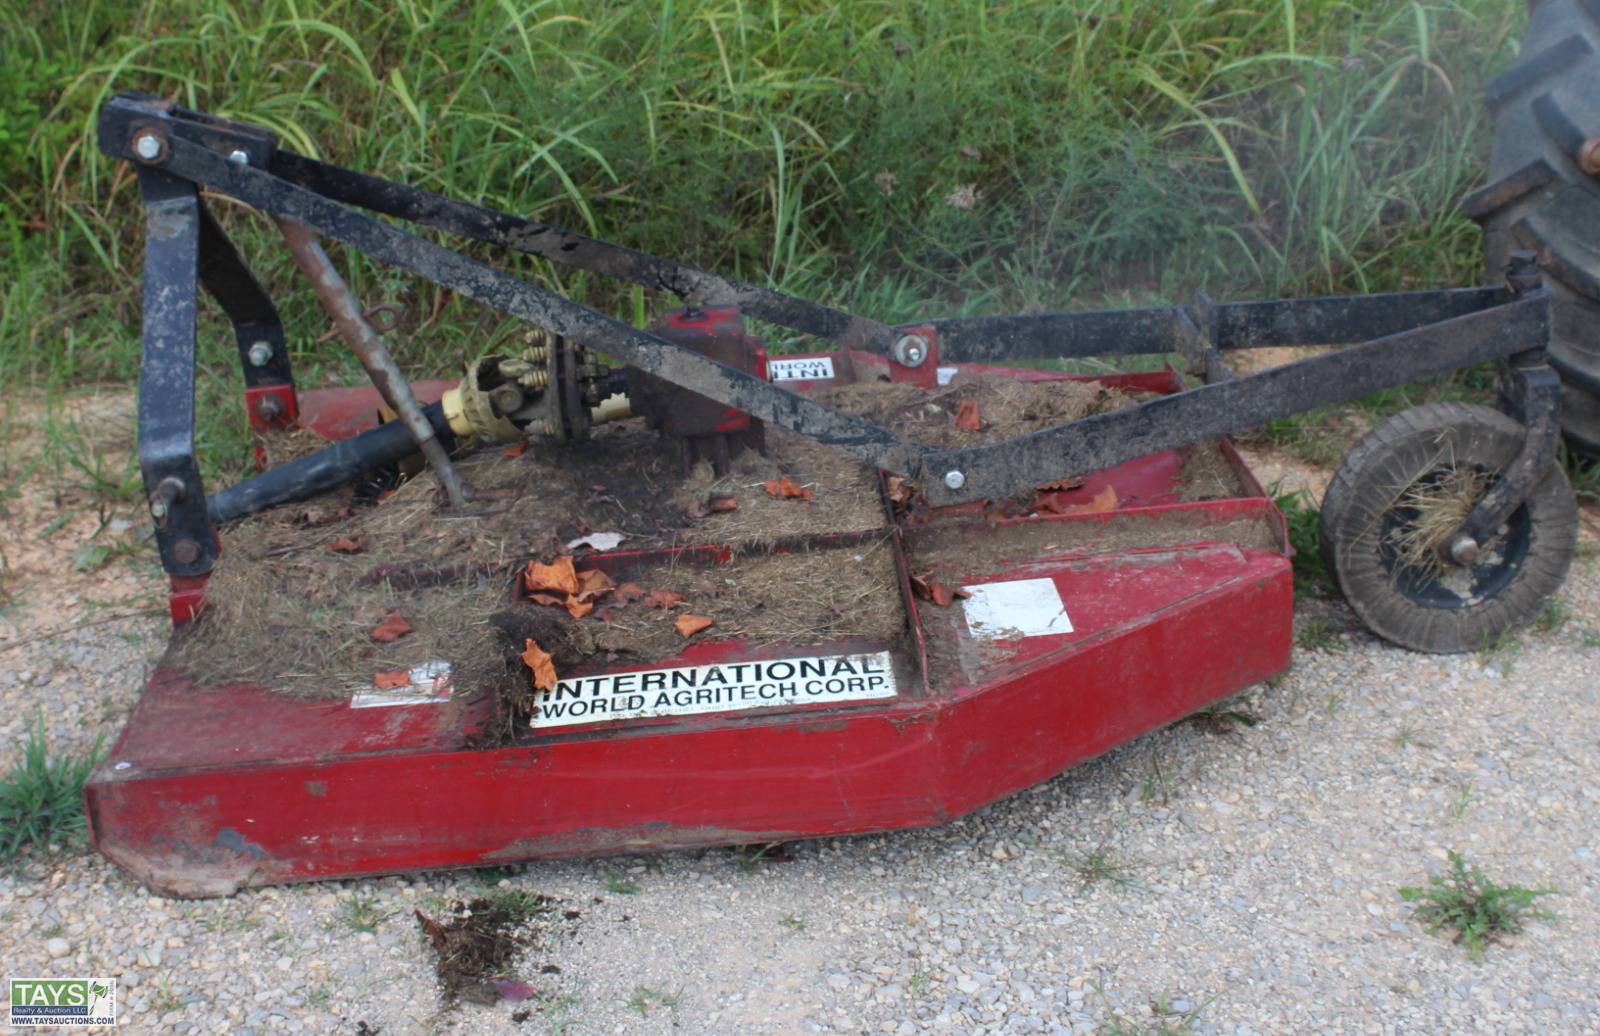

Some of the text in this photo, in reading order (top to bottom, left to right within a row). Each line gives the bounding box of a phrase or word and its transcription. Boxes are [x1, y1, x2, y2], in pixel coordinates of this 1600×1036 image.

[543, 694, 645, 718] WORLD
[654, 682, 798, 708] AGRITECH
[805, 676, 889, 695] CORP.
